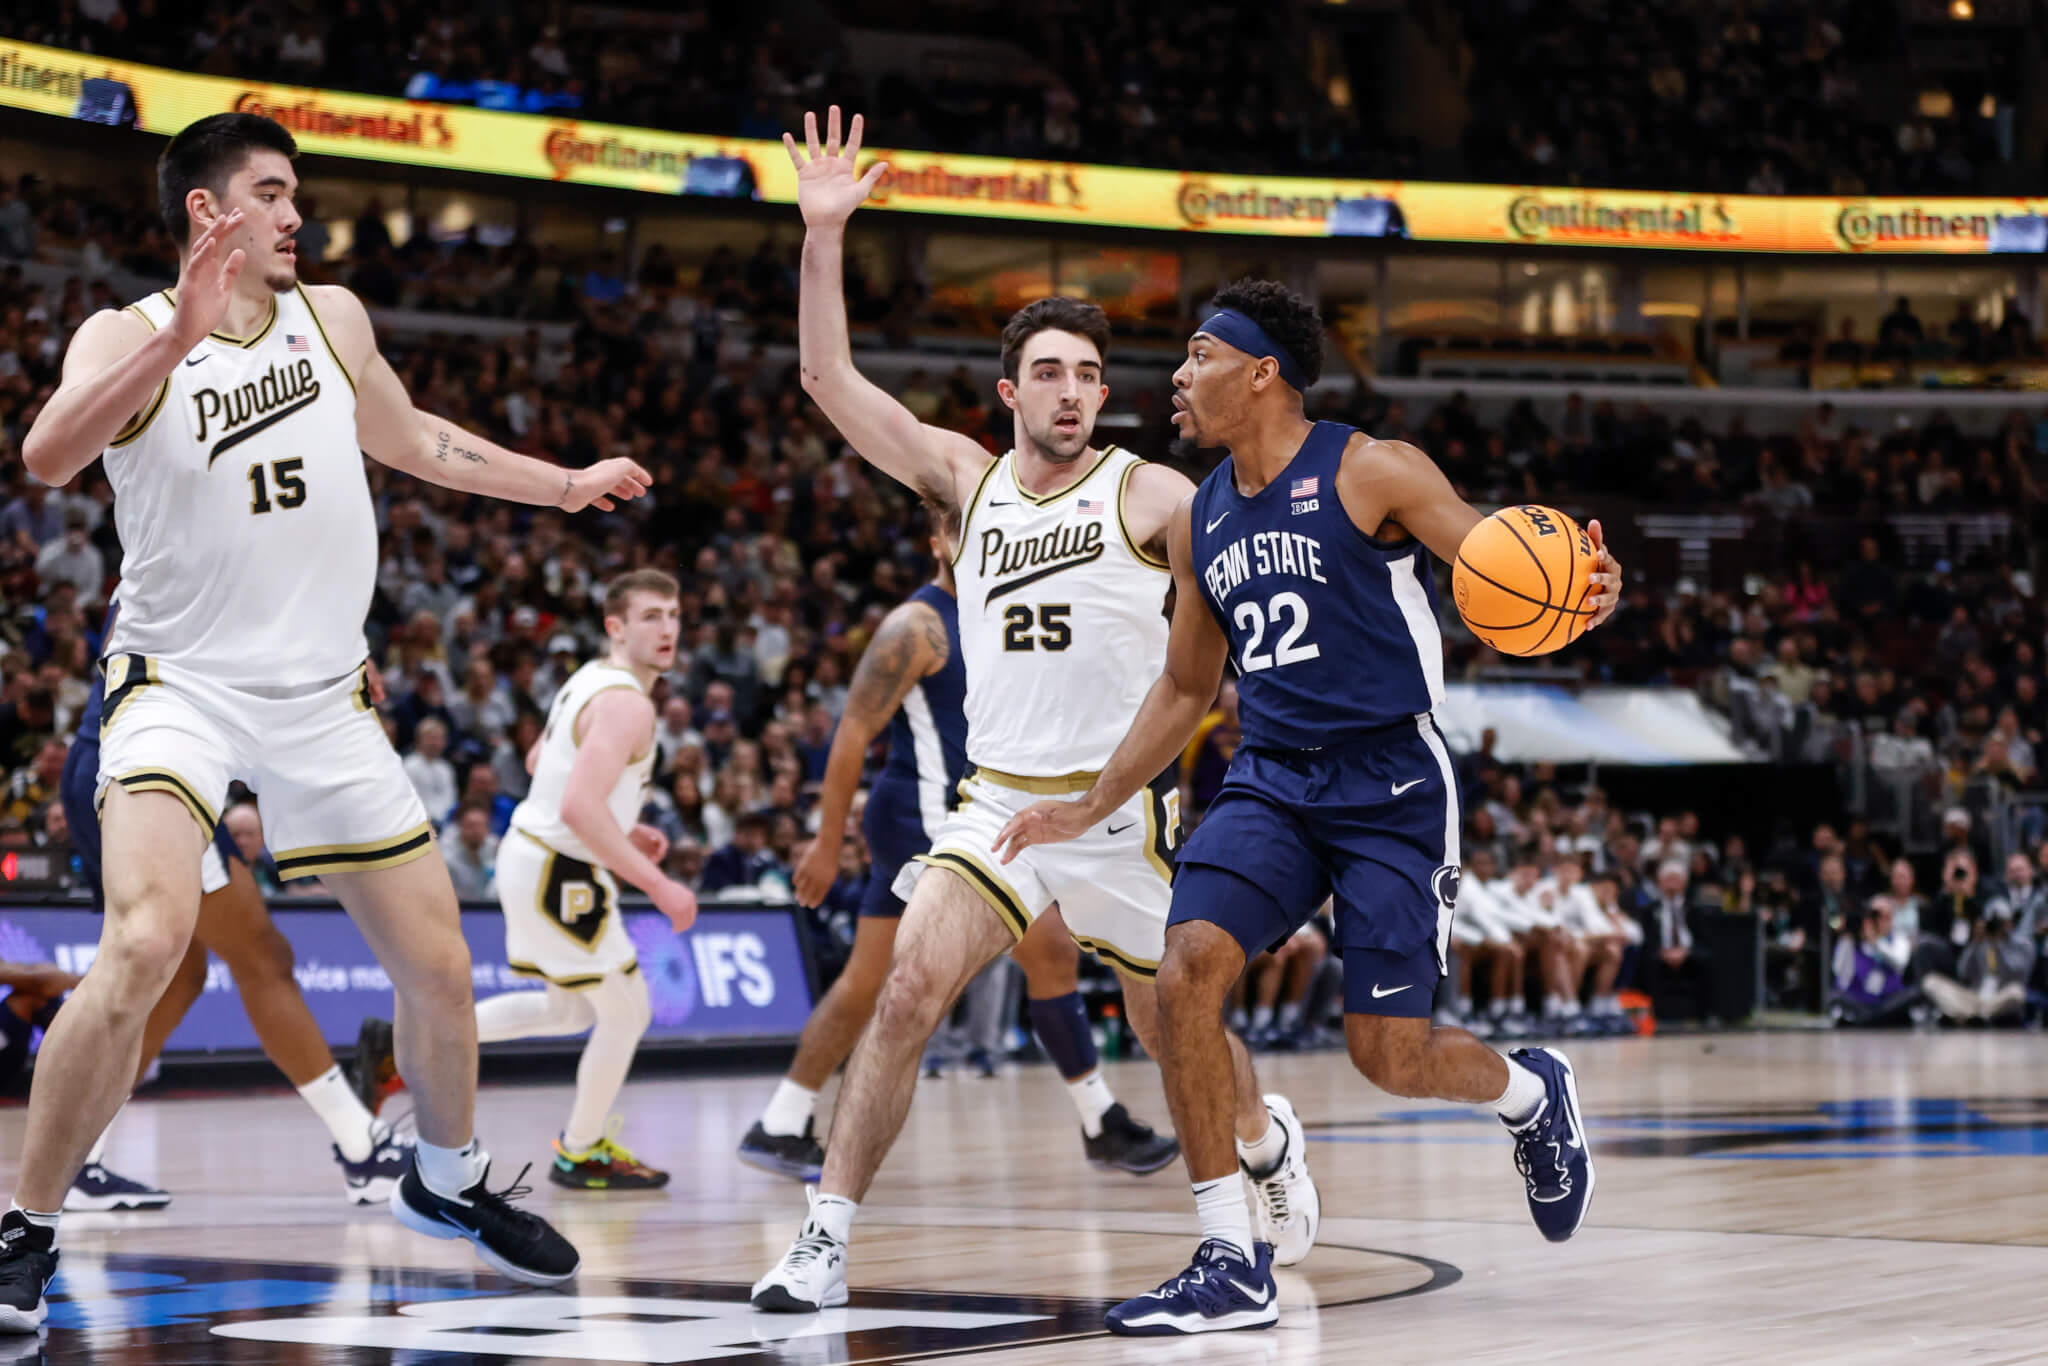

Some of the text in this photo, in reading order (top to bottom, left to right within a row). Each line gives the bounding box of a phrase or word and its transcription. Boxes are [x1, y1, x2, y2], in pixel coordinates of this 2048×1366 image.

[0, 51, 86, 98] tinen
[544, 129, 693, 181] Continen
[1177, 182, 1341, 228] Continen
[1508, 196, 1702, 239] Continental
[1837, 206, 2000, 251] Continen
[190, 358, 321, 442] Purdue
[247, 456, 307, 515] 15
[1518, 505, 1558, 536] CAA
[979, 519, 1105, 578] Purdue
[1204, 531, 1328, 612] PENN STATE
[1003, 603, 1072, 652] 25
[1233, 591, 1321, 673] 22
[691, 932, 776, 1007] IFS
